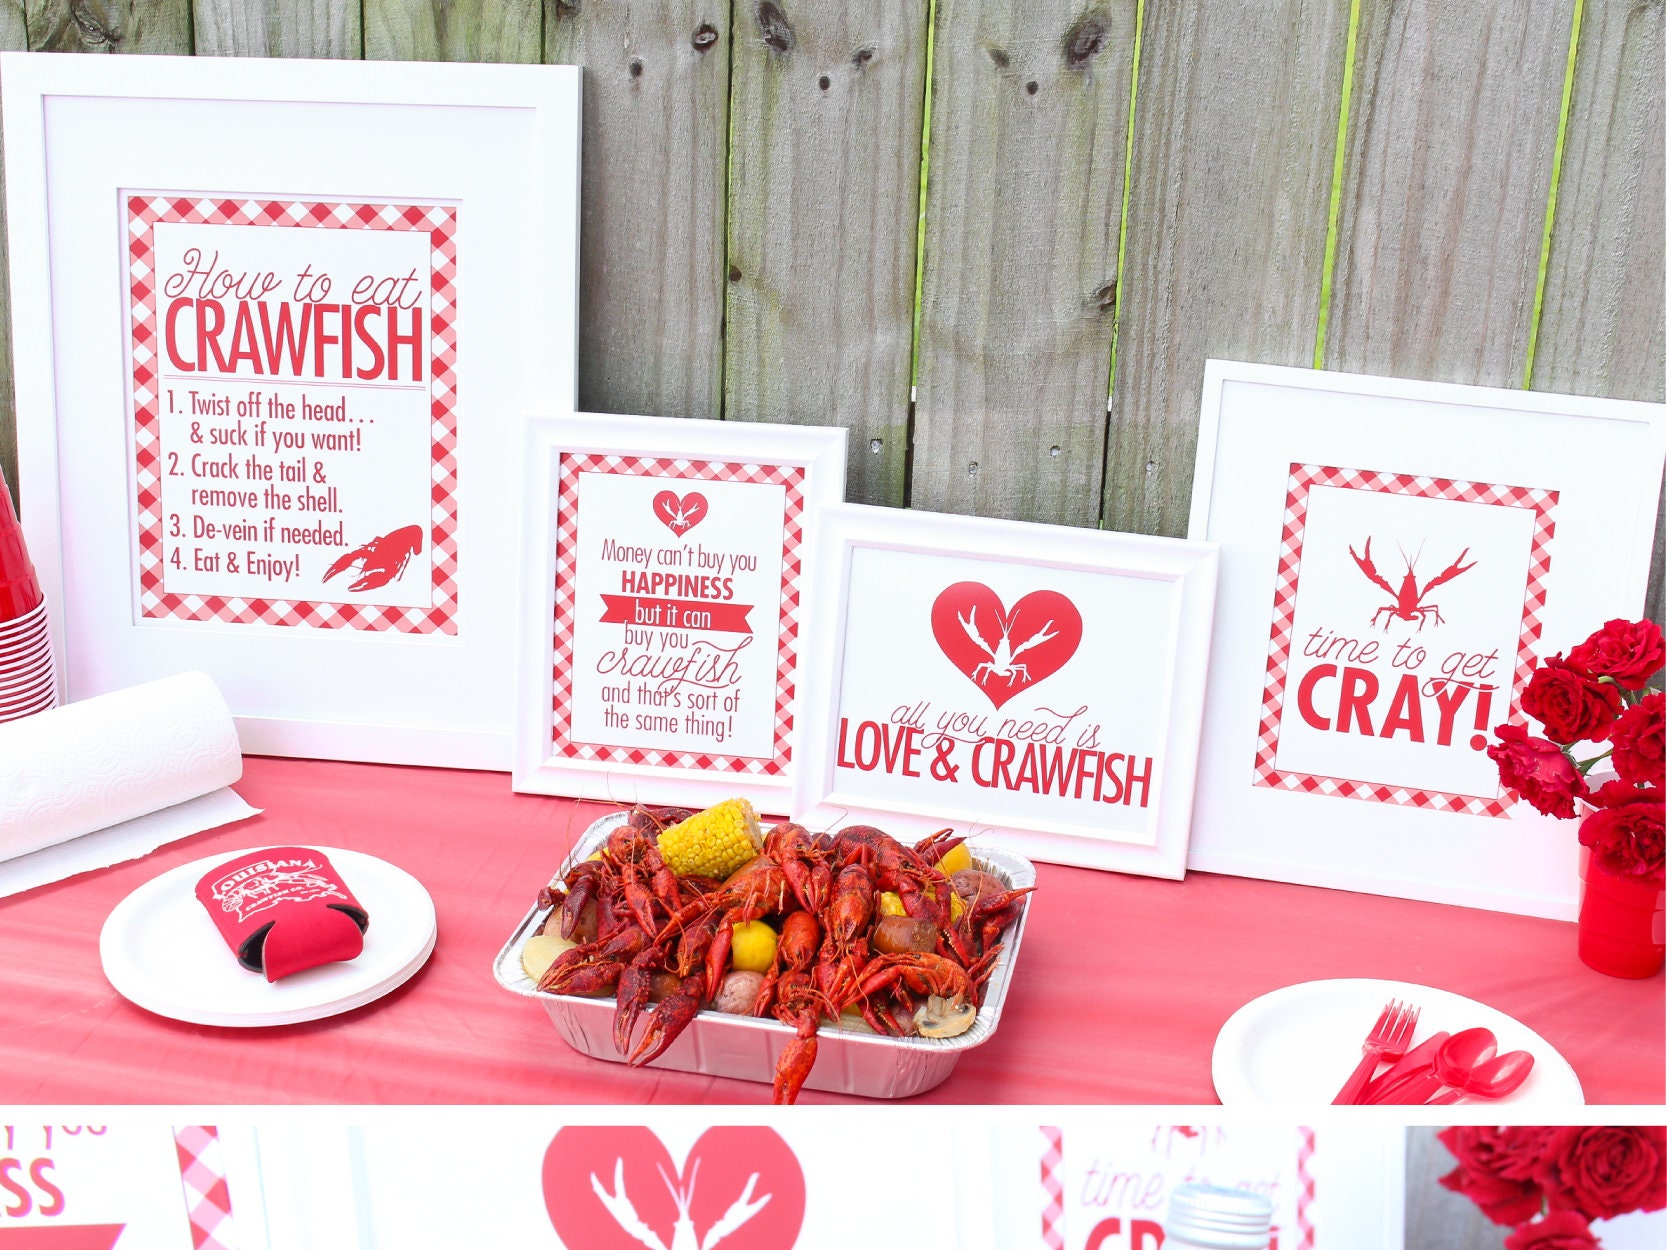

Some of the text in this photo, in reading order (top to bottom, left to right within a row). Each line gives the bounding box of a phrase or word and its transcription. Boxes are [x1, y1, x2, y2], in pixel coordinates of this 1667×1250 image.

[164, 248, 423, 310] How to eat
[164, 297, 423, 382] CRAWFISH
[167, 390, 183, 414] 1.
[189, 391, 230, 417] Twist
[237, 393, 261, 419] off
[268, 394, 295, 421] the
[190, 420, 361, 453] & suck if you want!
[168, 453, 327, 484] 2. Crack the tail &
[192, 484, 343, 513] remove the shell.
[169, 515, 349, 548] 3. De-vein if needed.
[170, 547, 300, 582] 4. Eat & Enjoy!
[601, 538, 757, 576] Money can't buy you
[621, 570, 733, 600] HAPPINESS
[635, 599, 711, 629] but it can
[624, 620, 689, 652] buy you
[596, 635, 753, 697] crawfish
[1303, 626, 1500, 697] time to get
[601, 681, 741, 713] and that's sort of
[1297, 663, 1494, 751] CRAY!
[604, 704, 733, 743] the same thing!
[890, 700, 1101, 749] all you need is
[837, 717, 1153, 808] LOVE & CRAWFISH
[1081, 1158, 1165, 1210] time
